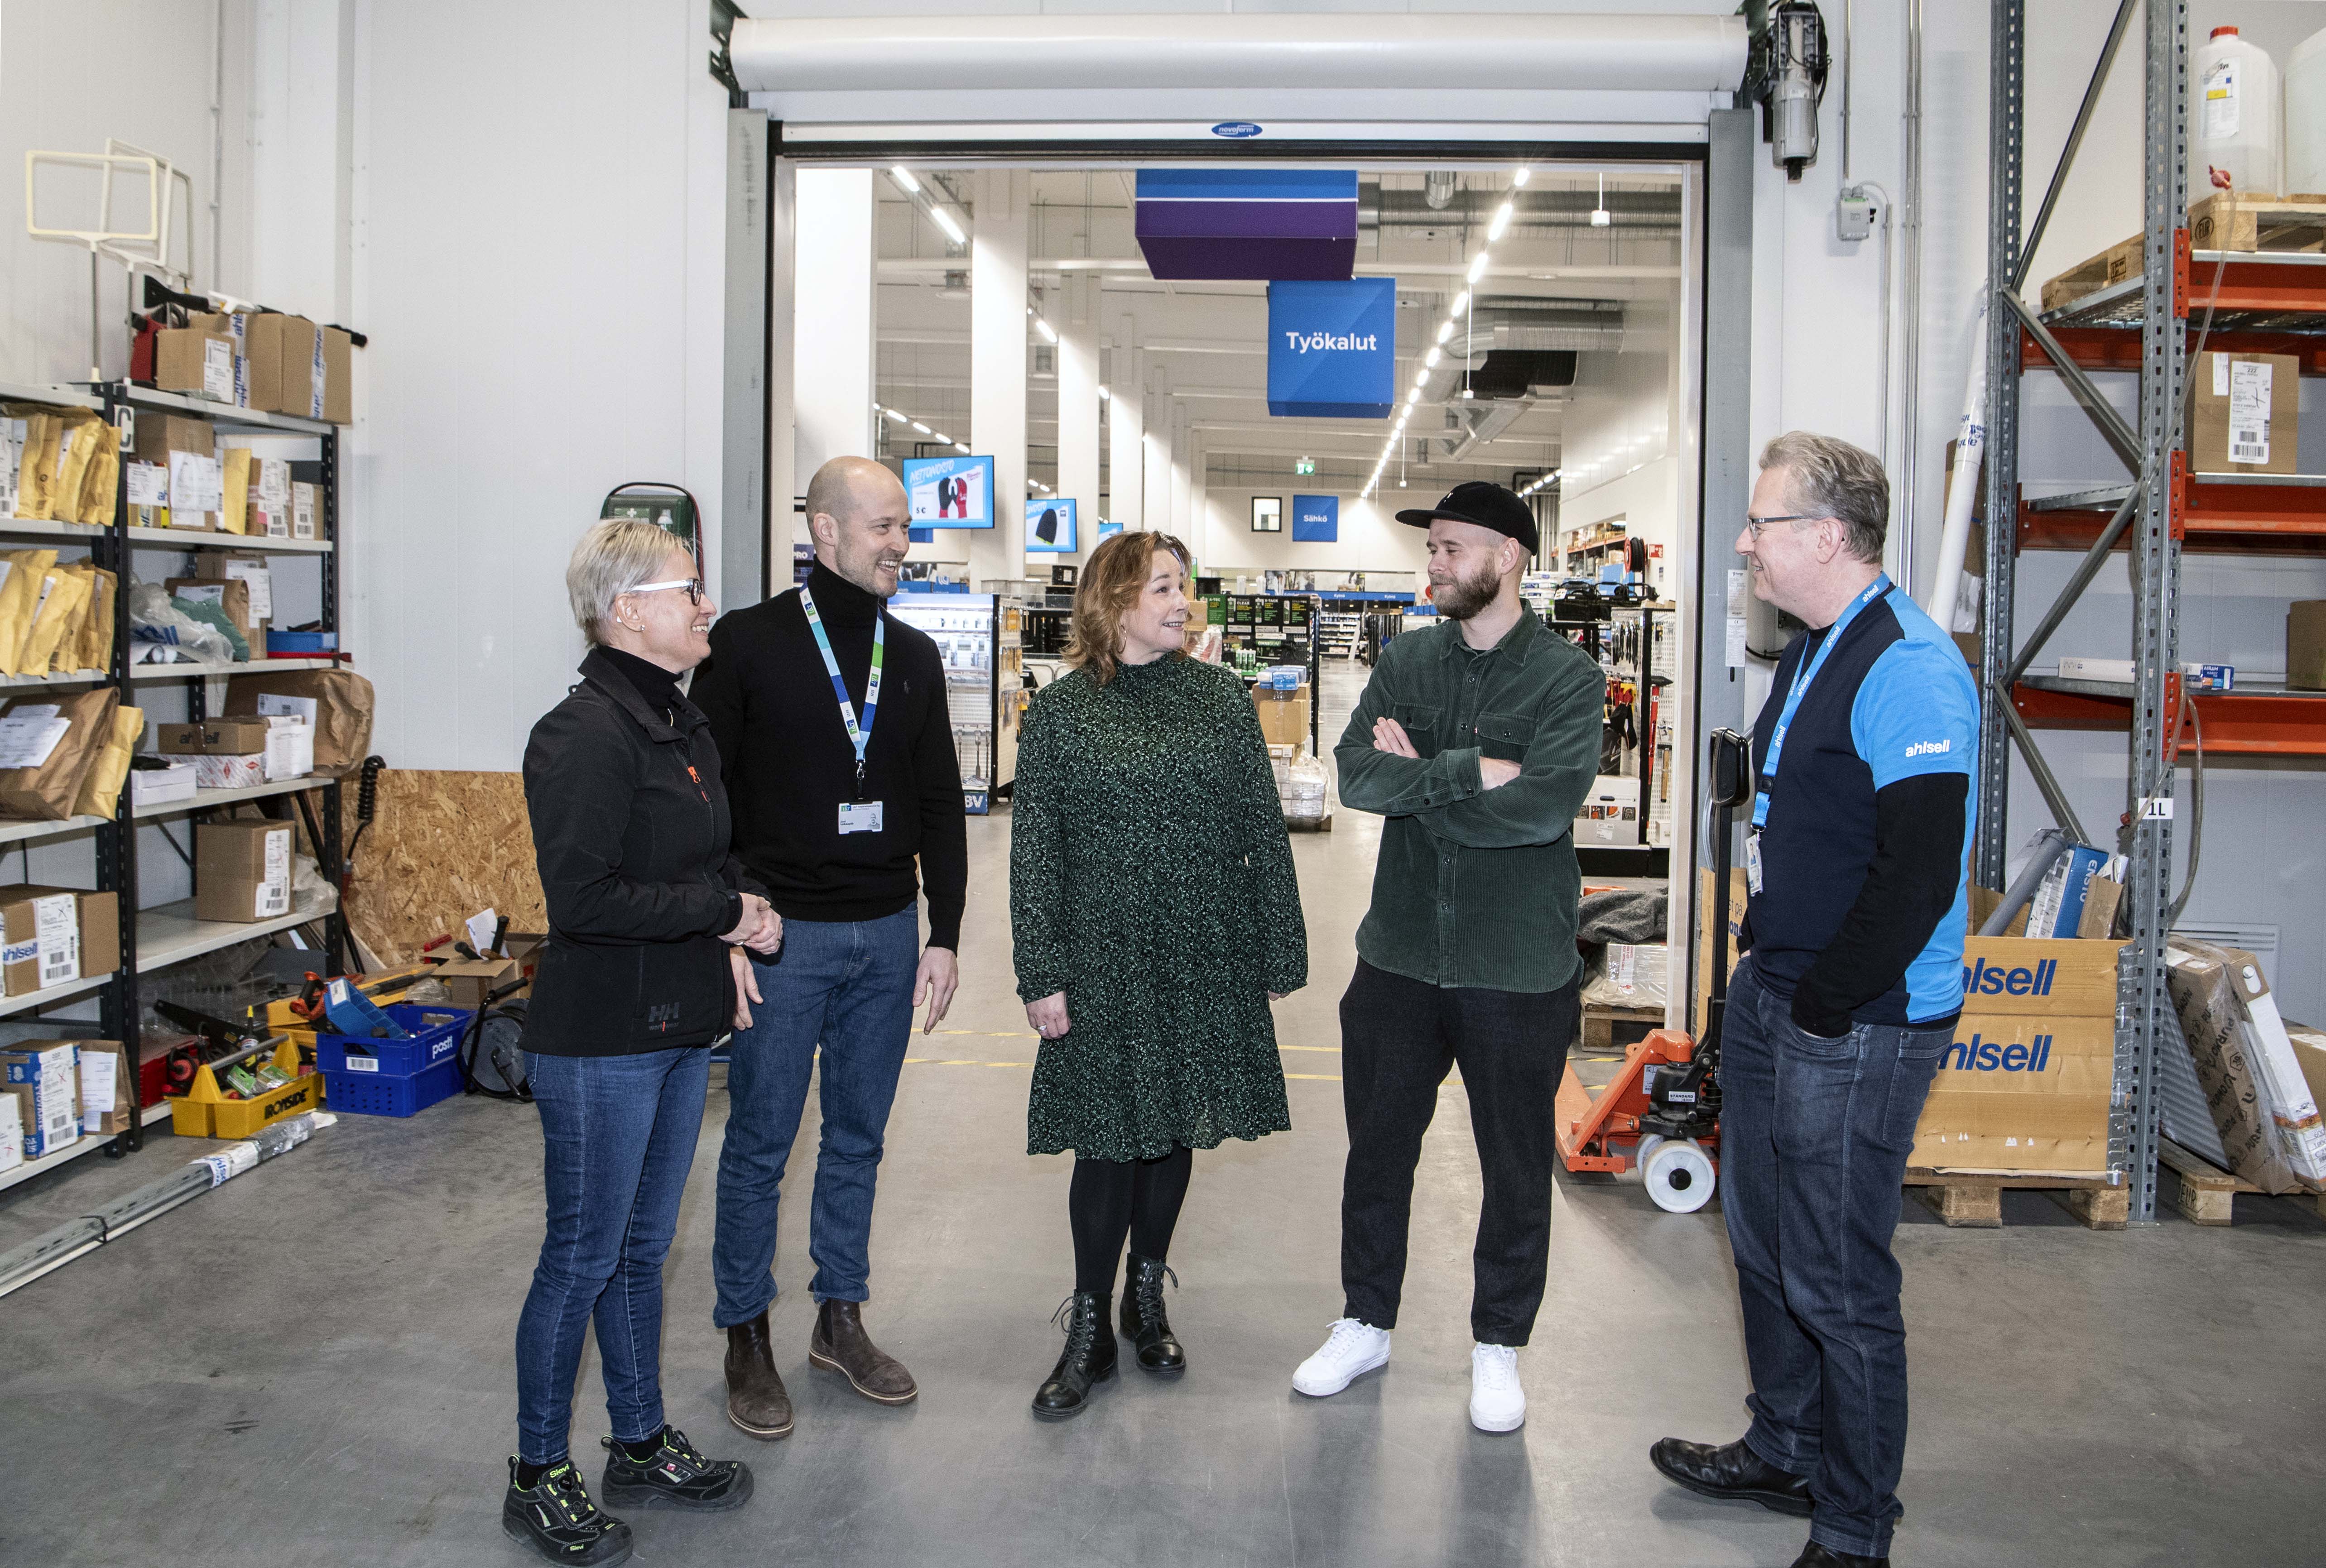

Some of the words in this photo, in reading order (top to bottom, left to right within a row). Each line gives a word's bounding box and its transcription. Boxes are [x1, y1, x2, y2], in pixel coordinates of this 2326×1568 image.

[1218, 124, 1254, 135] novoferm
[2197, 221, 2211, 239] EUR
[1286, 331, 1377, 354] Työkalut
[117, 408, 132, 447] C
[909, 460, 955, 484] NETTONOSTO
[1303, 513, 1328, 523] Sähkö
[1861, 584, 1879, 604] ahlsell
[1826, 625, 1842, 649] ahlsell
[1797, 674, 1812, 698] ahlsell
[1774, 725, 1787, 748] ahlsell
[1905, 739, 1951, 759] ahlsell
[2147, 802, 2166, 816] 1L
[1735, 900, 1743, 917] på
[648, 1001, 682, 1022] HH
[432, 1034, 454, 1059] posti
[2211, 1017, 2235, 1056] PURMO
[264, 1086, 309, 1120] IRONSIDE
[2179, 1184, 2196, 1207] EUR
[549, 1463, 570, 1479] Sievi
